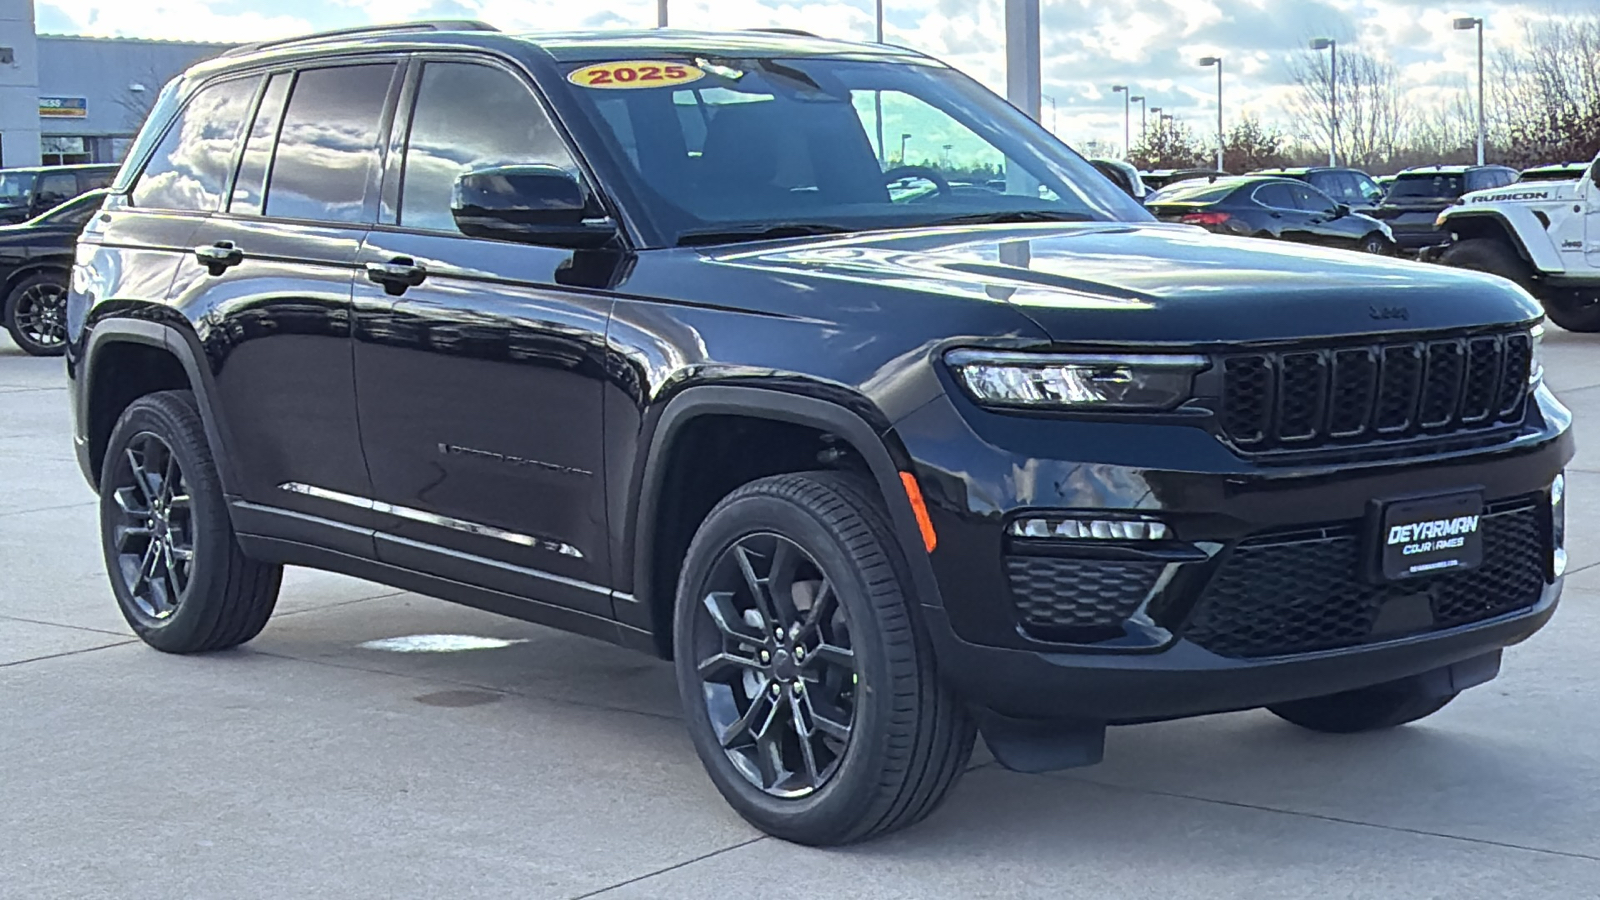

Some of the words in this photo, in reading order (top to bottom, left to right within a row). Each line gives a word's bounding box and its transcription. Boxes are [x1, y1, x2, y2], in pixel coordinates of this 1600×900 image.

[588, 66, 688, 84] 2025
[1471, 191, 1548, 203] RUBICON
[1387, 515, 1479, 545] DEYARMAN
[1436, 537, 1464, 550] AMES
